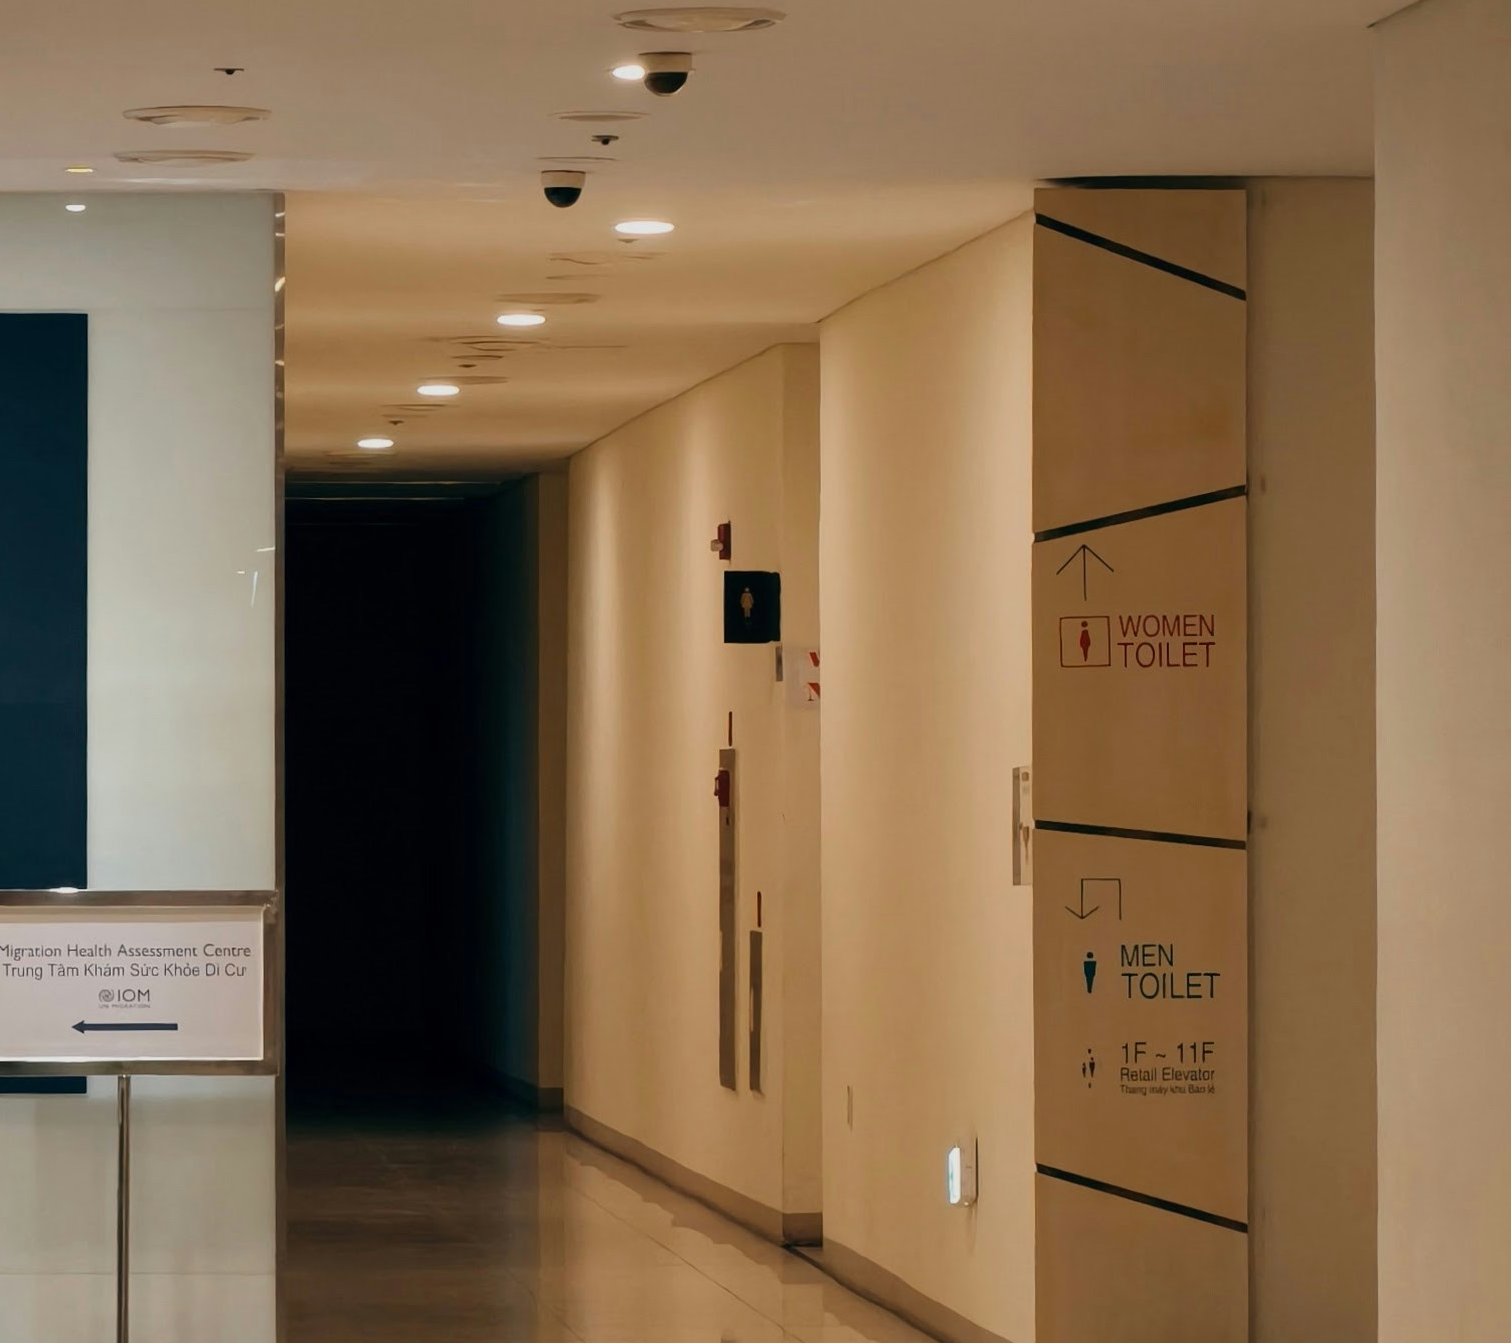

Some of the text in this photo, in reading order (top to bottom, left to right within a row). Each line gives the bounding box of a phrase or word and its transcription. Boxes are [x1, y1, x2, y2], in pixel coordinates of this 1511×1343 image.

[1118, 614, 1215, 638] WOMEN
[1117, 641, 1216, 669] TOILET
[67, 943, 112, 958] Health
[117, 943, 198, 958] Assessment
[203, 943, 251, 958] Centre
[1120, 943, 1174, 967] MEN
[2, 963, 43, 981] Trung
[47, 963, 79, 977] Tâm
[84, 962, 125, 977] Khám
[205, 963, 220, 977] Di
[224, 962, 247, 977] Cư
[117, 988, 151, 1002] IOM
[1120, 972, 1221, 1000] TOILET
[1121, 1041, 1147, 1064] 1F
[1176, 1041, 1215, 1064] 11F
[1120, 1067, 1215, 1082] Retail Elevator
